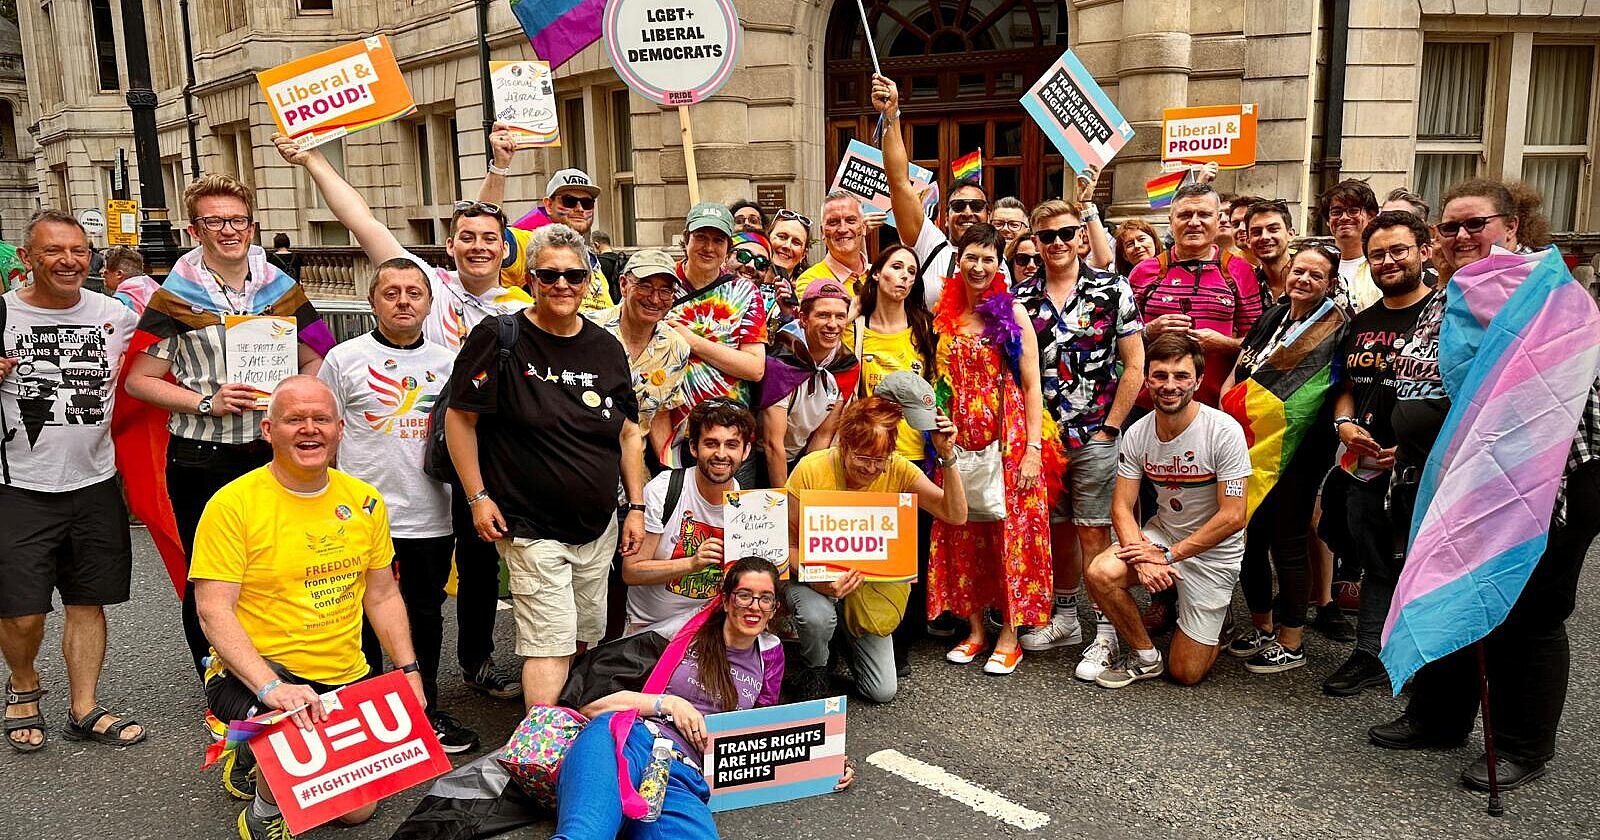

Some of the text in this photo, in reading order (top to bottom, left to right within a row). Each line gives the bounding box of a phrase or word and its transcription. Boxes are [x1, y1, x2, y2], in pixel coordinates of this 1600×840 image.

[647, 8, 694, 22] LGBT+
[641, 27, 704, 42] LIBERAL
[628, 44, 723, 62] DEMOCRATS
[275, 63, 371, 107] Liberal &
[669, 91, 692, 100] PRIDE
[284, 84, 368, 126] PROUD!
[1042, 88, 1071, 124] RIGHTS
[1049, 82, 1094, 137] ARE HUMAN
[1056, 73, 1108, 139] TRANS RIGHTS
[1170, 122, 1237, 138] Liberal &
[1169, 137, 1228, 152] PROUD!
[850, 161, 878, 177] TRANS
[563, 175, 588, 185] VANS
[842, 178, 874, 196] RIGHTS
[846, 170, 890, 193] ARE HUMA
[39, 333, 57, 343] AND
[58, 334, 100, 344] PERVERTS
[6, 349, 50, 357] ESBIANS
[66, 369, 109, 377] SUPPORT
[400, 429, 409, 438] &
[1145, 453, 1199, 474] benetton
[809, 514, 894, 532] Liberal &
[809, 537, 884, 553] PROUD!
[306, 556, 362, 576] FREEDOM
[304, 578, 328, 588] from
[268, 692, 412, 777] U=U
[718, 729, 821, 755] TRANS RIGHTS
[718, 745, 806, 769] ARE HUMAN
[301, 746, 424, 801] #FIGHTHIVSTIGMA
[718, 765, 771, 783] RIGHTS
